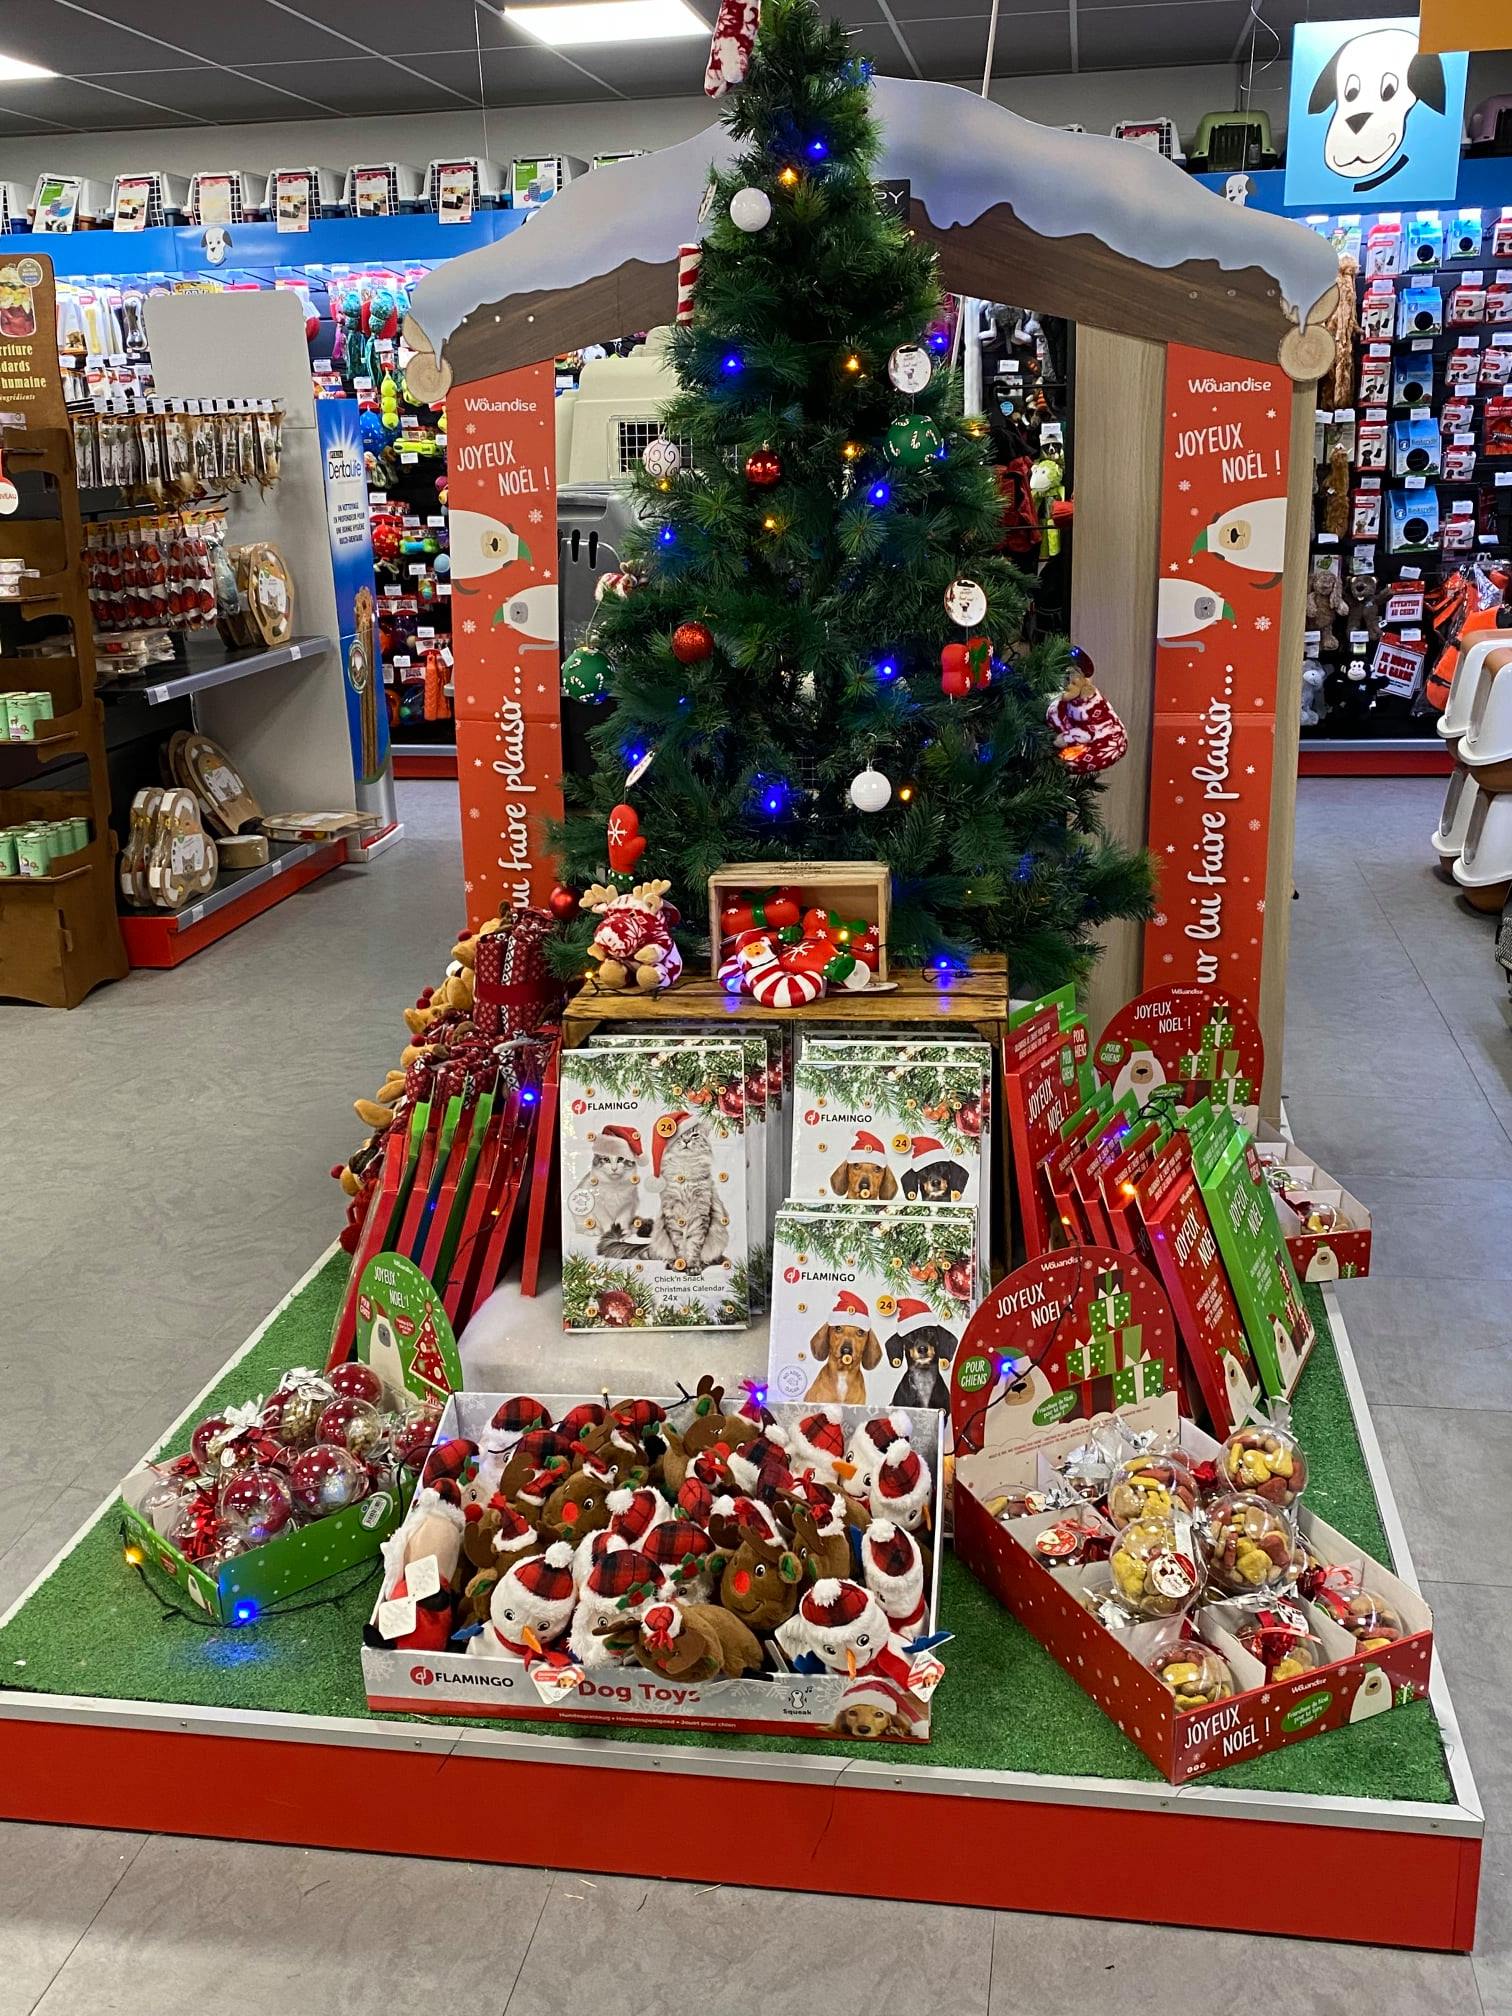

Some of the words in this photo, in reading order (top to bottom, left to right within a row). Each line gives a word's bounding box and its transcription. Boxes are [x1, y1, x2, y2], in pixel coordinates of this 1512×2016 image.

[0, 360, 30, 372] dards
[1, 376, 46, 389] humaine
[1175, 423, 1243, 458] JOYEUX
[457, 440, 516, 472] JOYEUX
[1222, 450, 1267, 484] NOËL
[1276, 450, 1280, 475] !
[498, 466, 538, 496] NOËL
[544, 466, 550, 490] !
[498, 803, 532, 872] faire
[1187, 811, 1227, 886] faire
[1184, 892, 1222, 940] lui
[1134, 1000, 1172, 1020] JOYEUX
[1101, 1053, 1120, 1063] CHIENS
[1105, 1043, 1120, 1053] POUR
[588, 1102, 638, 1111] FLAMINGO
[1028, 1075, 1053, 1124] JOYEUX
[821, 1114, 872, 1123] FLAMINGO
[1228, 1180, 1249, 1234] JOYEUX
[1174, 1208, 1201, 1268] JOYEUX
[374, 1266, 396, 1287] JOYEUX
[801, 1272, 855, 1282] FLAMINGO
[996, 1282, 1045, 1319] JOYEUX
[965, 1360, 985, 1373] POUR
[960, 1374, 988, 1387] CHIENS
[435, 1672, 513, 1687] FLAMINGO
[578, 1680, 632, 1702] Dog
[638, 1684, 700, 1705] Toys
[1184, 1704, 1240, 1749] JOYEUX
[1222, 1724, 1260, 1757] NOEL
